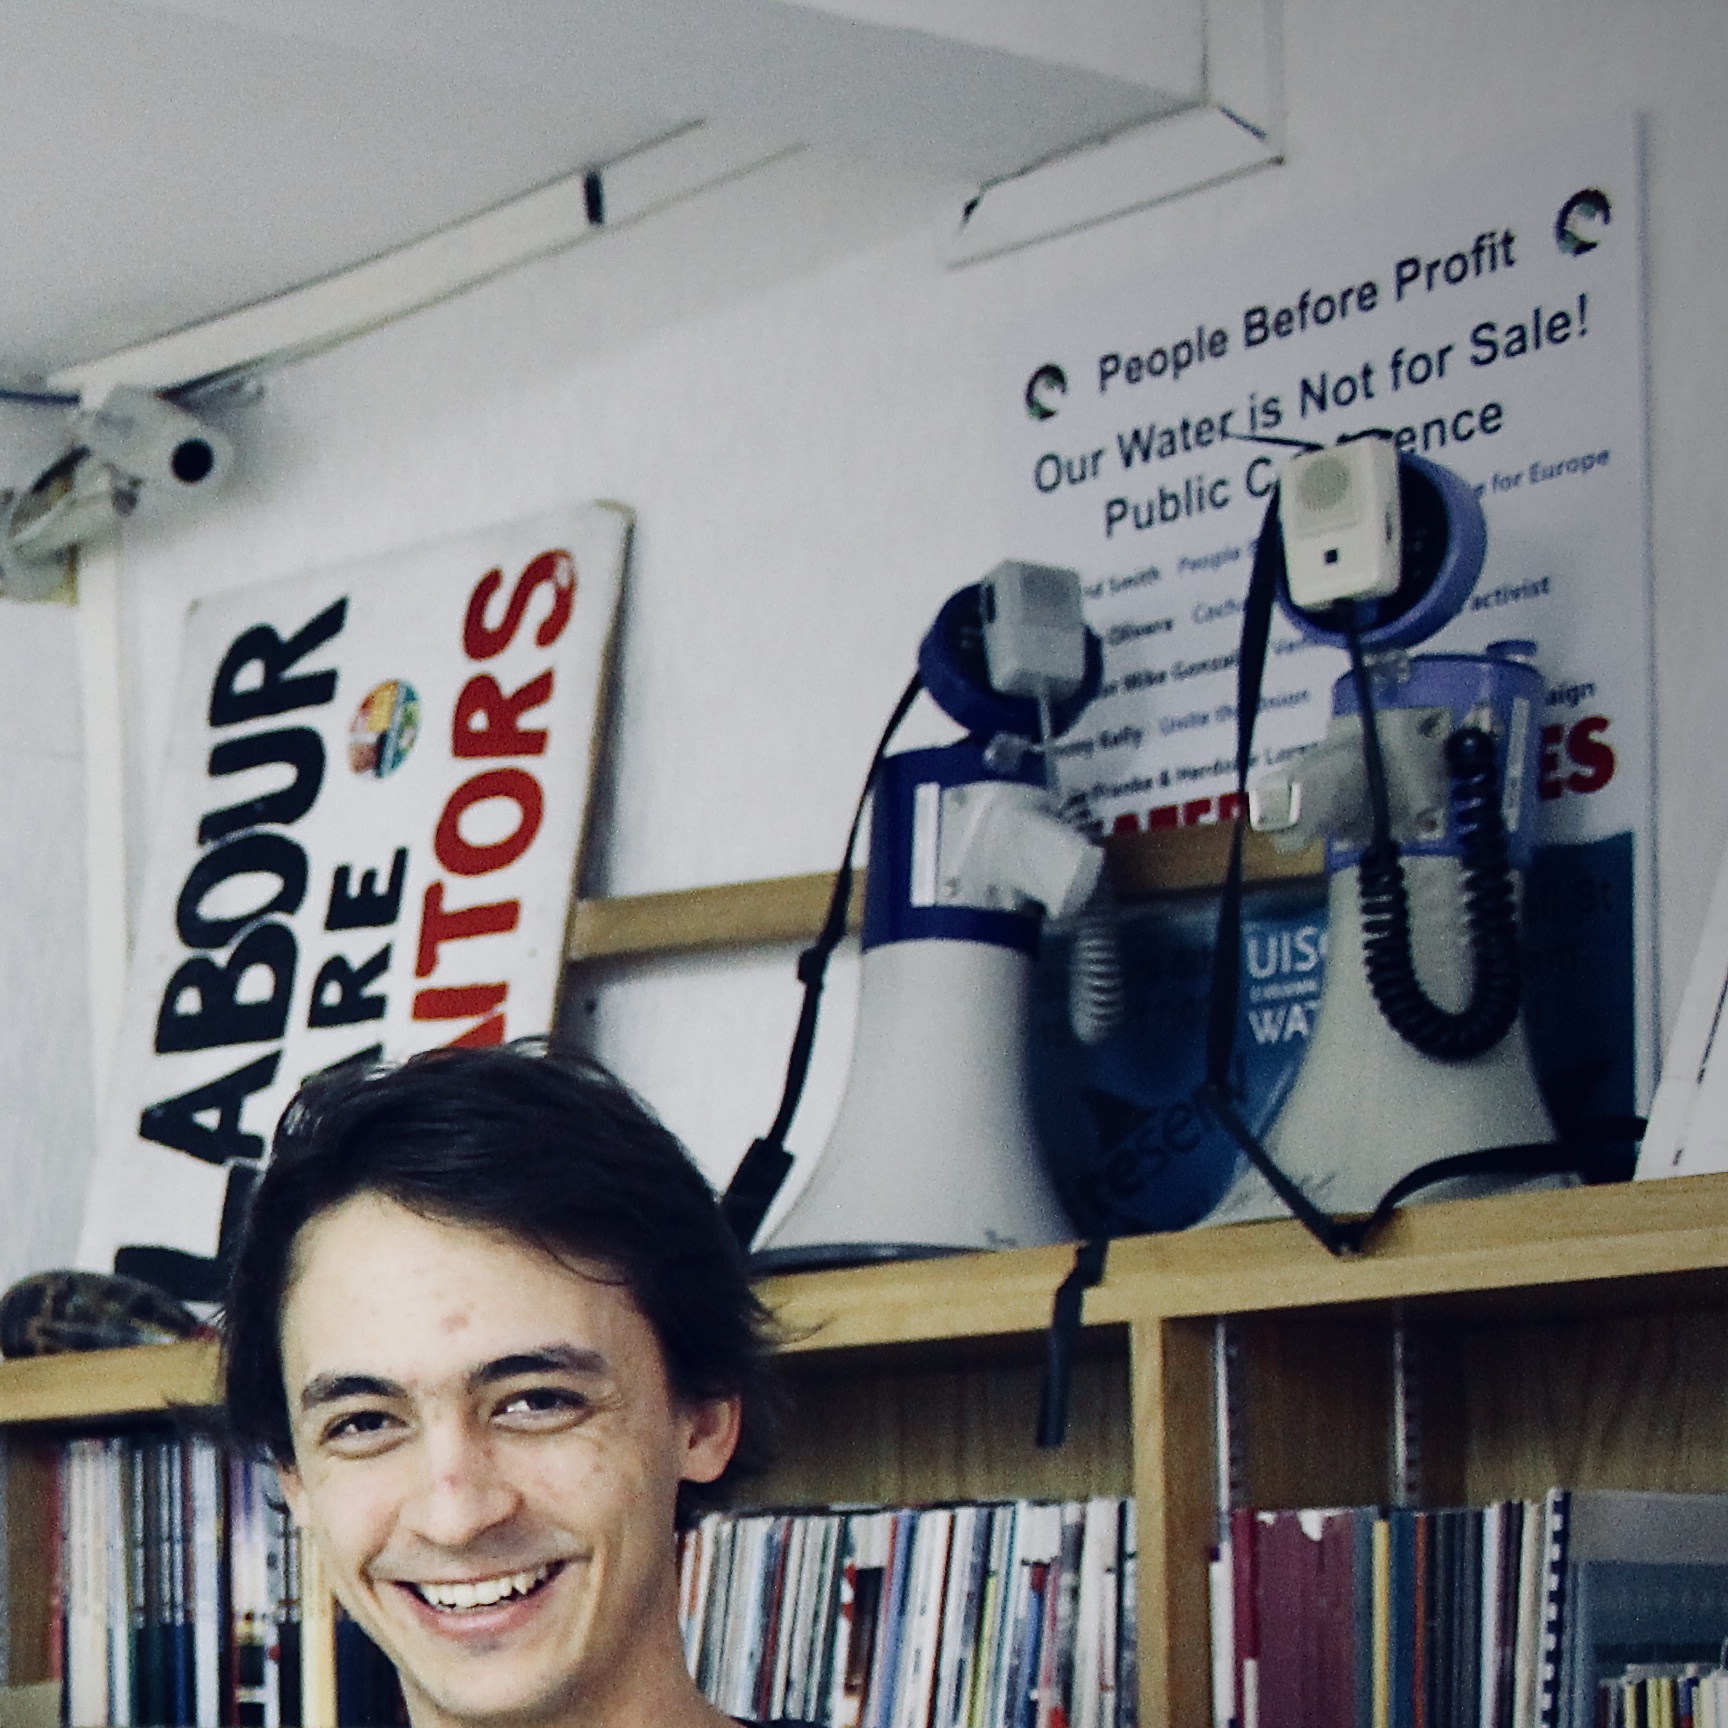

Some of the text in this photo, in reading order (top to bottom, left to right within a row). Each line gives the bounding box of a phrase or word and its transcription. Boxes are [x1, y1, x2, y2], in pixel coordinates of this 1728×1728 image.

[1097, 226, 1516, 394] People Before Profit
[1033, 293, 1591, 497] Our Water is Not for Sale!
[1105, 473, 1230, 540] Public
[1528, 449, 1610, 485] Europe
